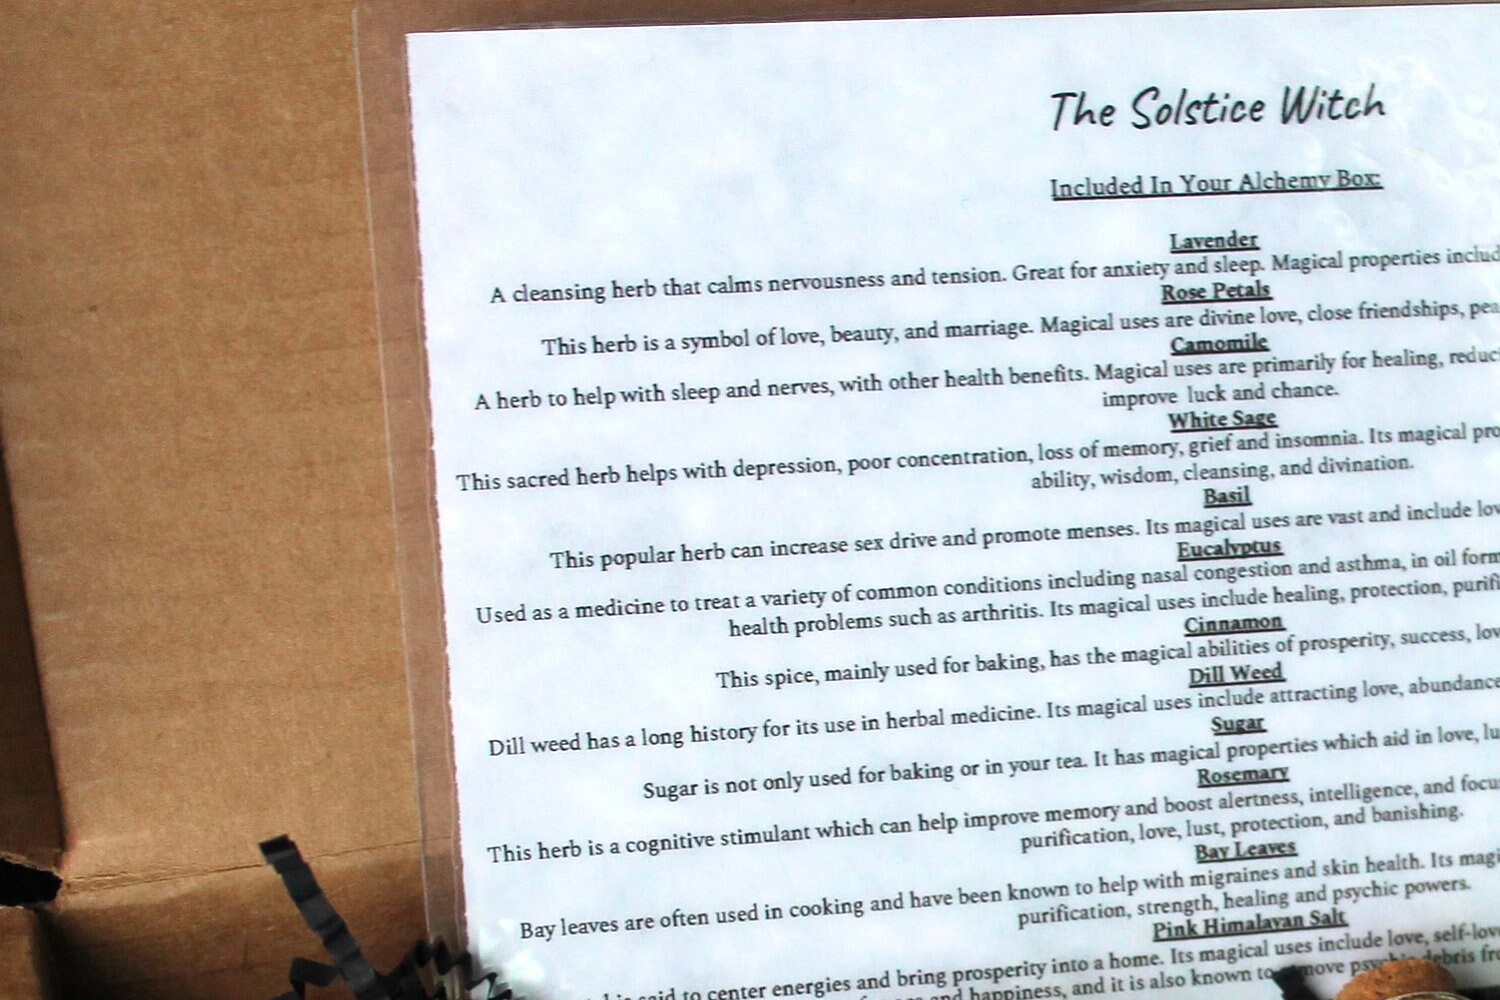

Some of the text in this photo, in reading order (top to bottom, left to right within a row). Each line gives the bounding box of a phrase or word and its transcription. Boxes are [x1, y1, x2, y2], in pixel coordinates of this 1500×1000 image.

[1051, 82, 1387, 132] The Solstice Witch
[1051, 168, 1383, 199] Included In Your Alchemy Box:
[1170, 230, 1260, 254] Lavender
[489, 284, 508, 305] A
[511, 283, 607, 306] cleansing
[610, 277, 658, 299] herb
[661, 276, 702, 297] that
[706, 274, 764, 295] calms
[767, 274, 886, 293] nervousness
[890, 266, 927, 287] and
[930, 266, 1008, 286] tension.
[1011, 262, 1066, 282] Great
[1069, 260, 1099, 280] for
[1101, 259, 1172, 282] anxiety
[1173, 254, 1210, 276] and
[1212, 254, 1266, 279] sleep.
[1270, 249, 1345, 277] Magical
[1347, 248, 1442, 275] properties
[1161, 279, 1273, 304] Rose Petals
[1170, 332, 1270, 356] Camomile
[474, 364, 1091, 412] A herb to help with sleep and nerves, with other health benefits.
[1101, 378, 1340, 412] improve luck and chance.
[1169, 409, 1279, 432] White Sage
[1030, 455, 1415, 495] ability, wisdom, cleansing, and divination.
[1202, 486, 1253, 508] Basil
[1176, 537, 1284, 561] Eucalyptus
[728, 615, 790, 639] health
[793, 612, 884, 641] problems
[888, 607, 934, 630] such
[936, 612, 958, 627] as
[960, 603, 1045, 625] arthritis.
[1049, 600, 1075, 620] Its
[1077, 594, 1152, 623] magical
[1155, 597, 1197, 614] uses
[1200, 588, 1269, 611] include
[1272, 584, 1347, 609] healing,
[1349, 579, 1449, 608] protection,
[1183, 614, 1287, 636] Cinnamon
[714, 669, 760, 691] This
[764, 668, 821, 693] spice,
[823, 660, 891, 686] mainly
[893, 656, 939, 679] used
[942, 656, 971, 676] for
[974, 652, 1047, 676] baking,
[1048, 649, 1082, 669] has
[1085, 646, 1118, 667] the
[1120, 640, 1194, 669] magical
[1196, 637, 1272, 660] abilities
[1274, 634, 1296, 655] of
[1297, 631, 1397, 659] prosperity,
[1399, 629, 1473, 647] success,
[1188, 662, 1287, 688] Dill Weed
[1210, 715, 1268, 736] Sugar
[1196, 764, 1291, 789] Rosemary
[485, 843, 533, 865] This
[536, 838, 583, 861] herb
[587, 839, 605, 857] is
[608, 841, 622, 855] a
[624, 831, 716, 859] cognitive
[719, 823, 812, 847] stimulant
[814, 816, 875, 840] which
[878, 820, 913, 836] can
[917, 811, 960, 836] help
[963, 810, 1041, 834] improve
[1043, 804, 1122, 825] memory
[1124, 795, 1159, 818] and
[1162, 794, 1214, 815] boost
[1217, 790, 1305, 811] alertness,
[1308, 781, 1421, 807] intelligence,
[1421, 774, 1457, 796] and
[1019, 801, 1465, 858] purification, love, lust, protection, and banishing.
[1194, 839, 1299, 863] Bay Leaves
[1017, 878, 1473, 934] purification, strength, healing and psychic powers.
[1151, 908, 1349, 942] Pink Himalayan Salt
[1071, 974, 1107, 997] and
[1110, 975, 1126, 994] it
[1128, 974, 1147, 992] is
[1148, 969, 1187, 990] also
[1189, 966, 1253, 987] known
[1255, 964, 1274, 981] to
[1423, 946, 1476, 965] debris
